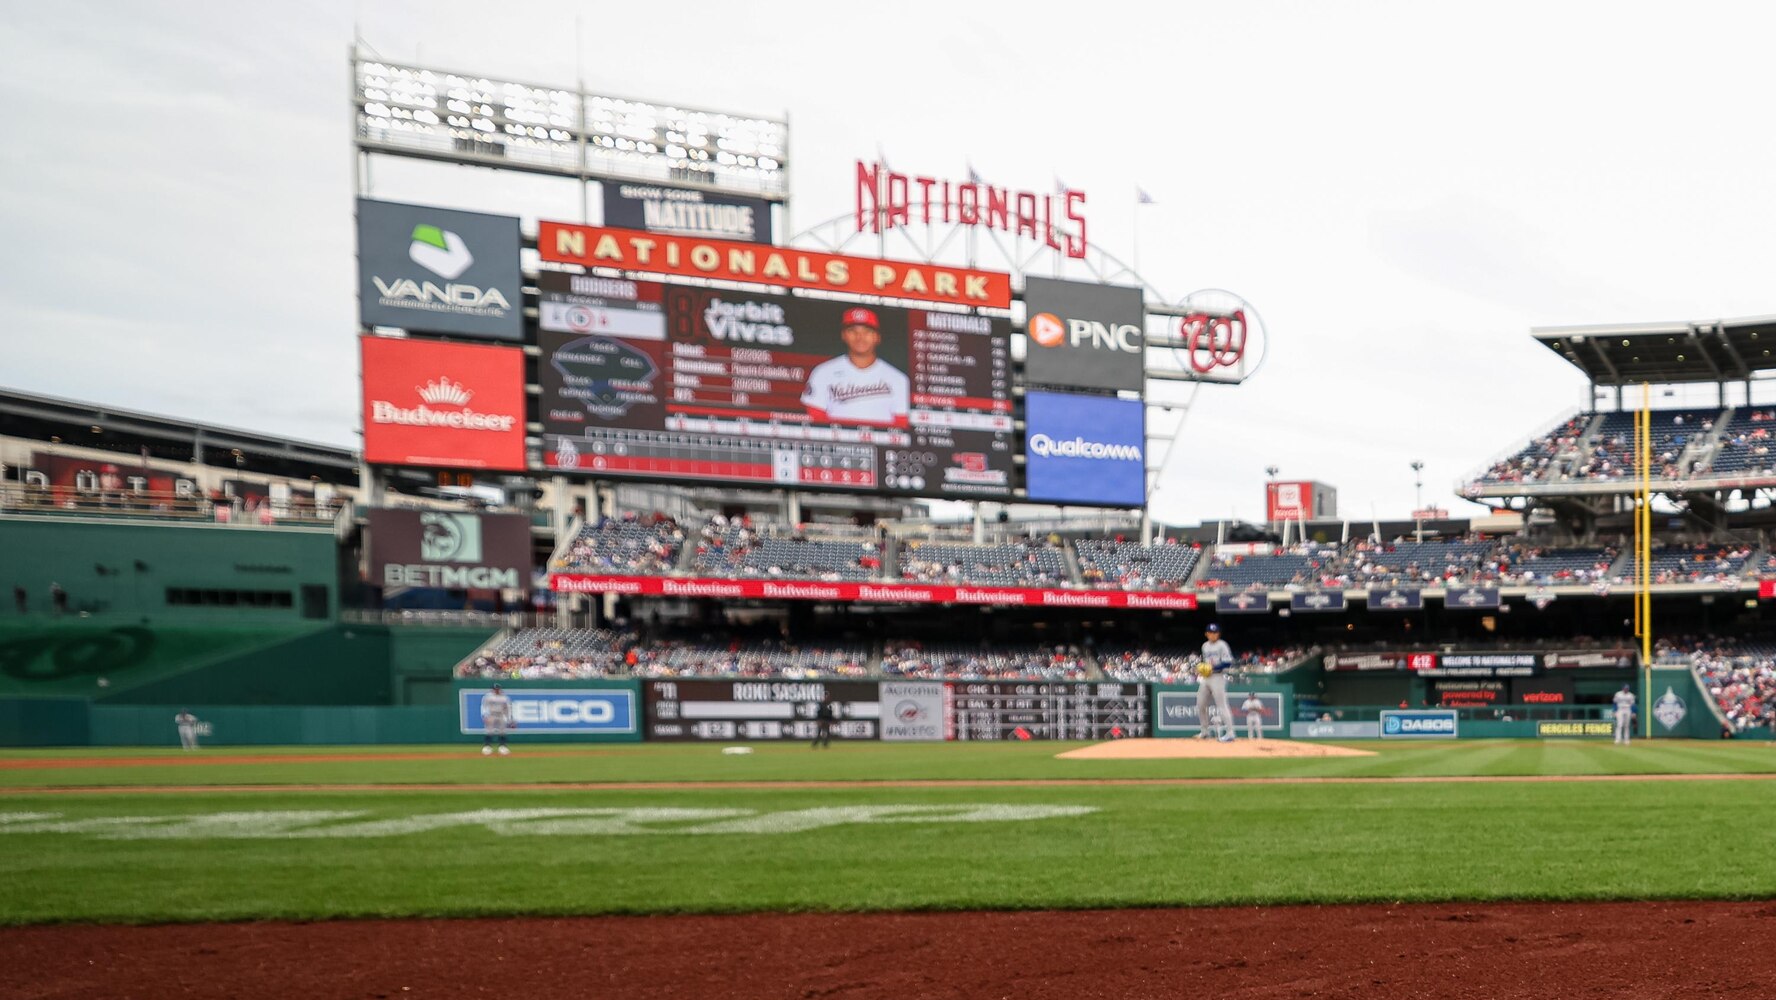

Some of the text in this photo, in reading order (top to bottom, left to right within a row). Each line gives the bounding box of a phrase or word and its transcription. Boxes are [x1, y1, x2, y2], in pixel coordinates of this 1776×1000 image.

[856, 160, 1086, 259] NATIONALS
[555, 227, 991, 300] NATIONALS PARK
[372, 275, 511, 311] VANDA
[704, 316, 795, 345] Vivas
[1067, 317, 1142, 353] PNC
[371, 400, 516, 432] Budweiser
[1029, 432, 1142, 462] Qualcomm
[383, 563, 520, 590] BETMGM
[508, 699, 615, 724] EICO
[1166, 705, 1225, 718] VENTR
[1522, 691, 1564, 703] verizon
